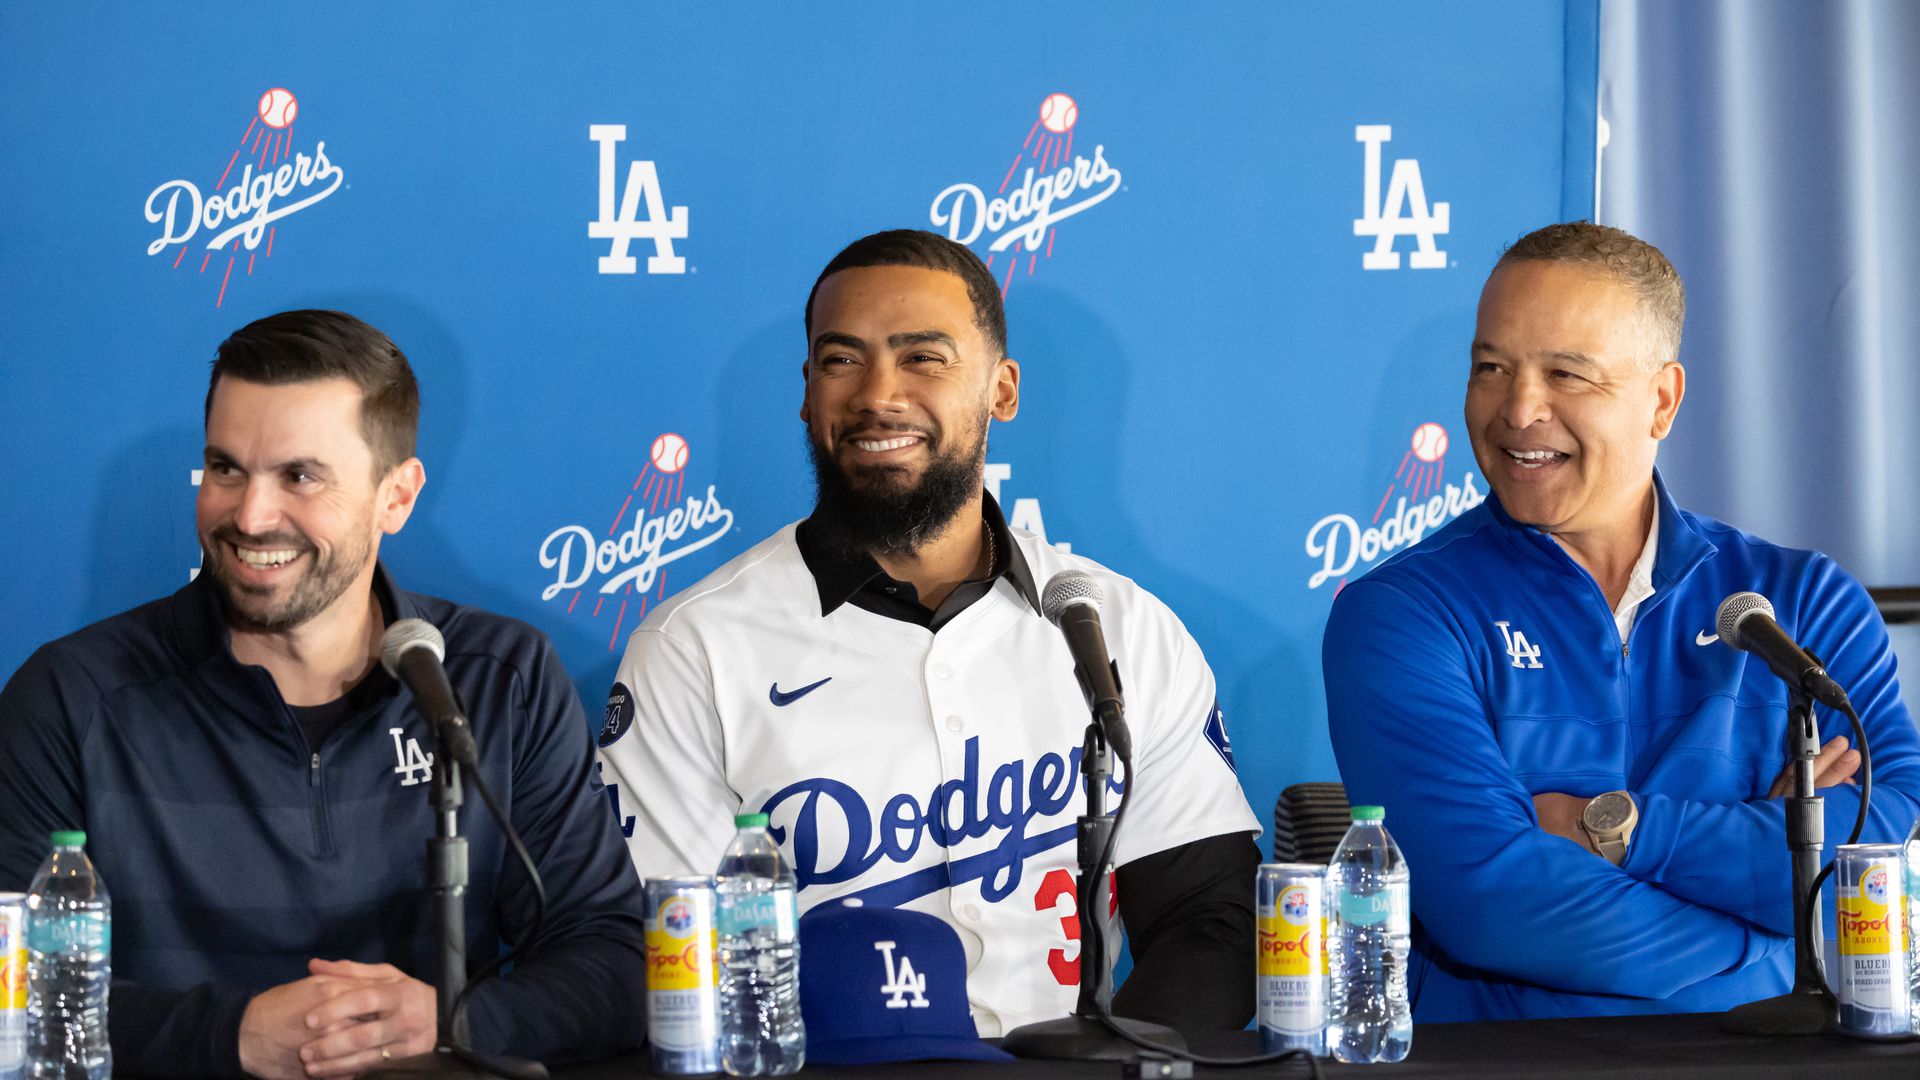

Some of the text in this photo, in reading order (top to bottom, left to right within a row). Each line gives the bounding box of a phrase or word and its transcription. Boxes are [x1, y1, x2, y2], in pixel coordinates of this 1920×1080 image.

[145, 141, 343, 255] Dodgers
[588, 124, 688, 274] LA
[930, 144, 1121, 252] Dodgers
[1354, 125, 1450, 270] LA
[539, 484, 733, 600] Dodgers
[1305, 472, 1486, 589] Dodgers
[1494, 621, 1544, 669] LA
[389, 727, 434, 786] LA
[874, 940, 930, 1008] LA
[1855, 960, 1890, 969] BLUEB
